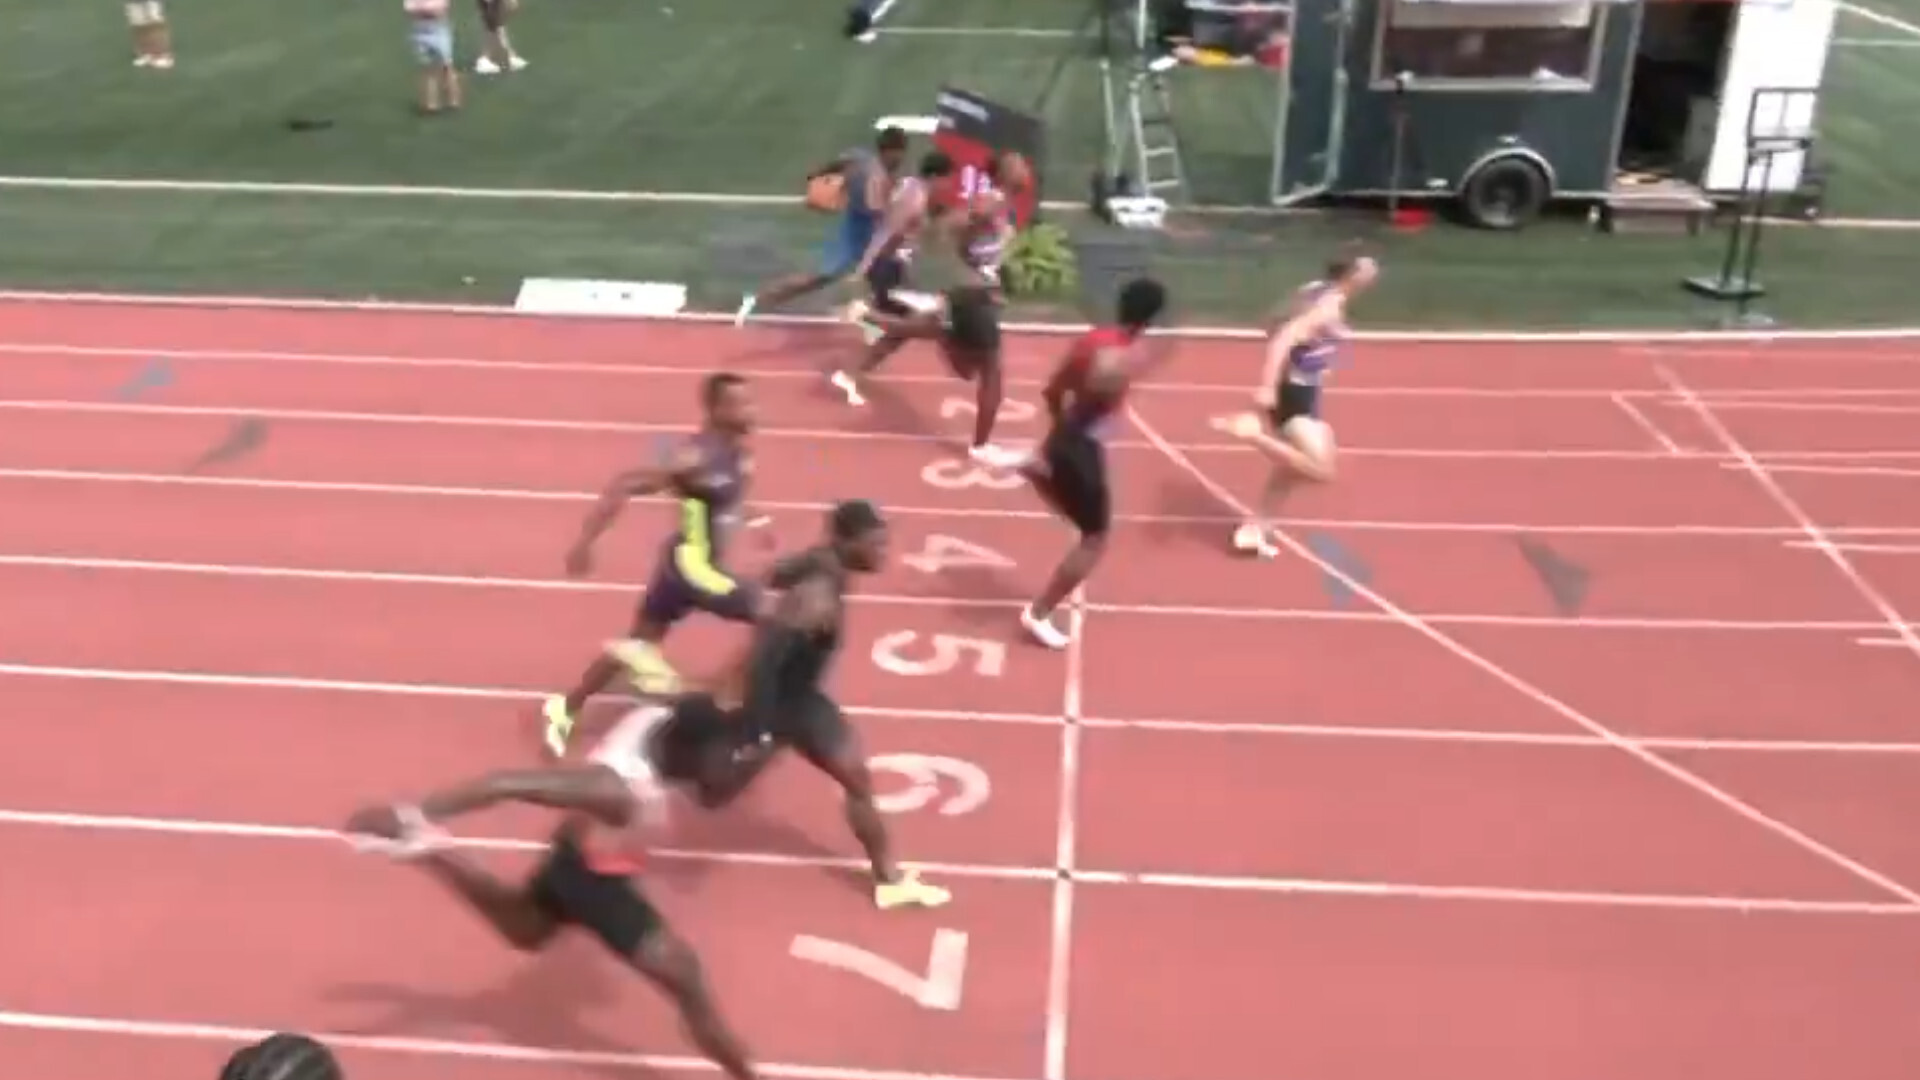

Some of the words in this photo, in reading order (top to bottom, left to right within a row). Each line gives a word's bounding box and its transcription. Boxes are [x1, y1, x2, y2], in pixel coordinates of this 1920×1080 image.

[942, 396, 1036, 420] 2
[920, 457, 1028, 489] 3
[902, 534, 1016, 572] 4
[871, 629, 1006, 678] 5
[866, 753, 990, 815] 6
[789, 928, 968, 1012] 7
